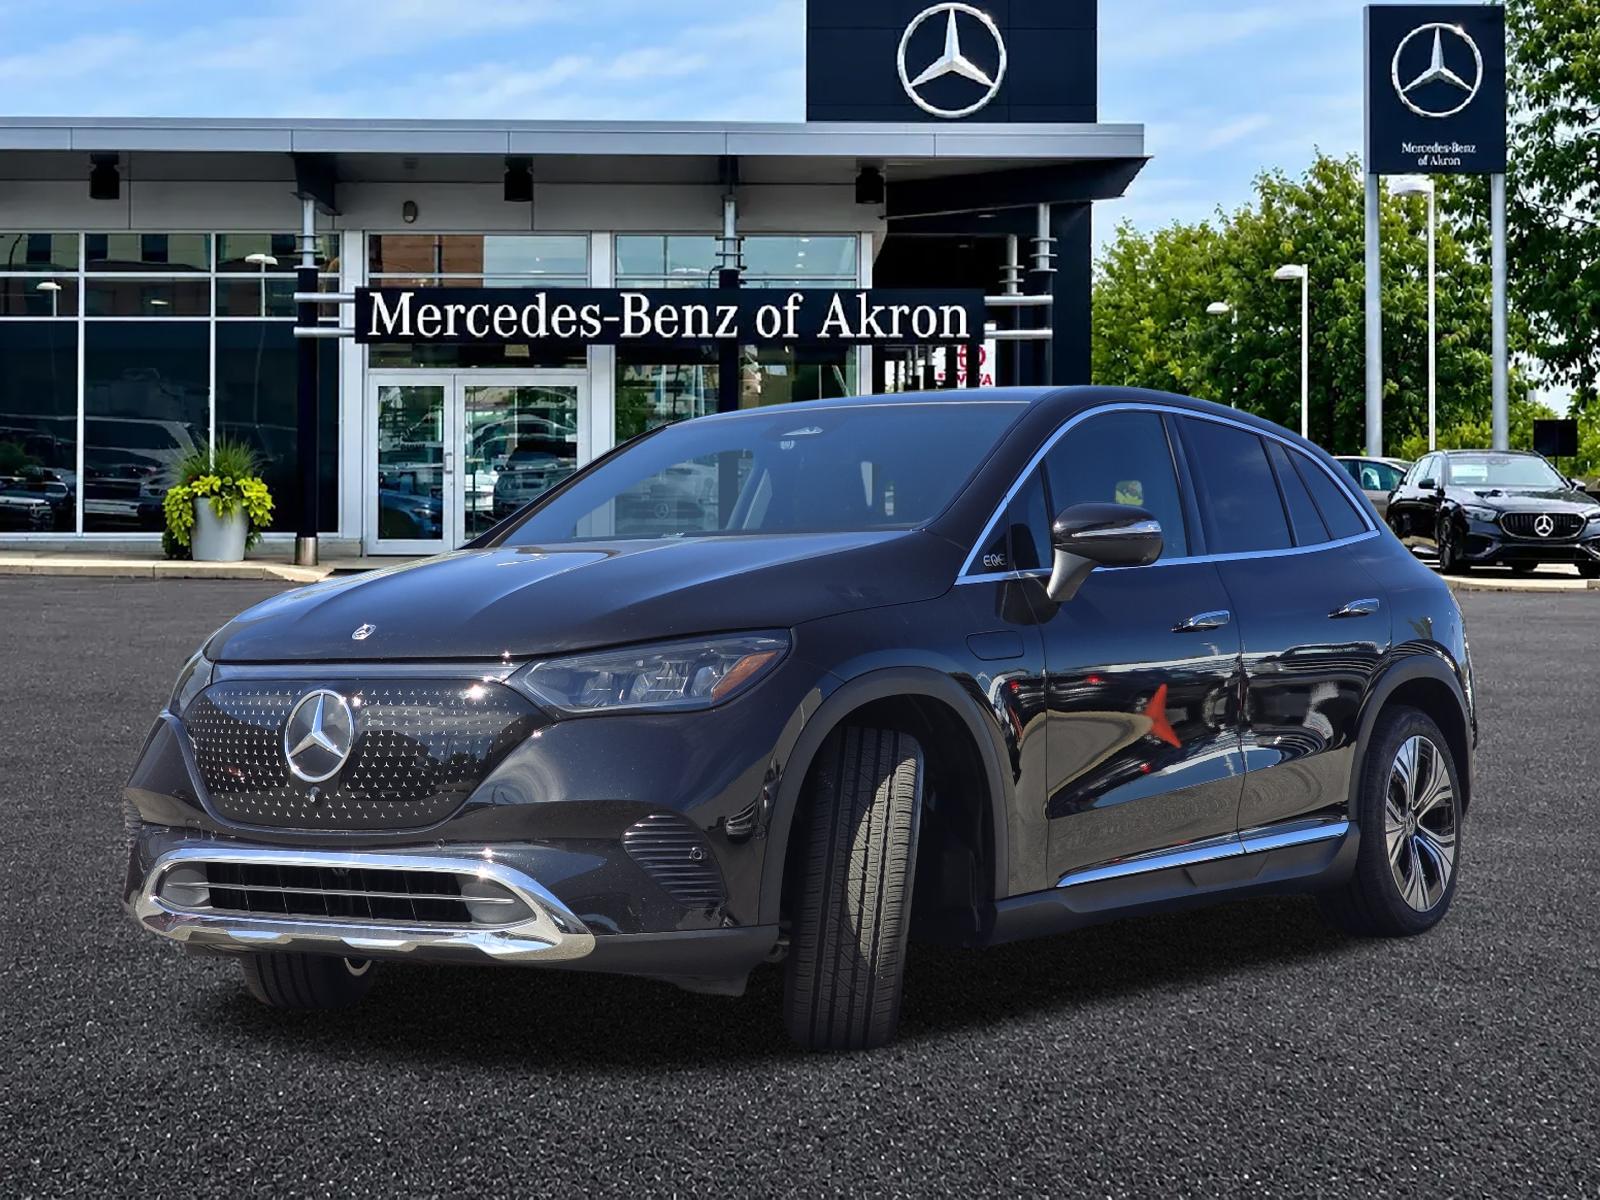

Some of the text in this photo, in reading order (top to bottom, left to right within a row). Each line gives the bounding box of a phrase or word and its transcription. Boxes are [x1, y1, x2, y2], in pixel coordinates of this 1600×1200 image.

[1401, 141, 1476, 153] Mercedes-Benz
[1417, 154, 1461, 166] of Akron
[367, 291, 971, 338] Mercedes-Benz of Akron
[983, 553, 1007, 567] EQE
